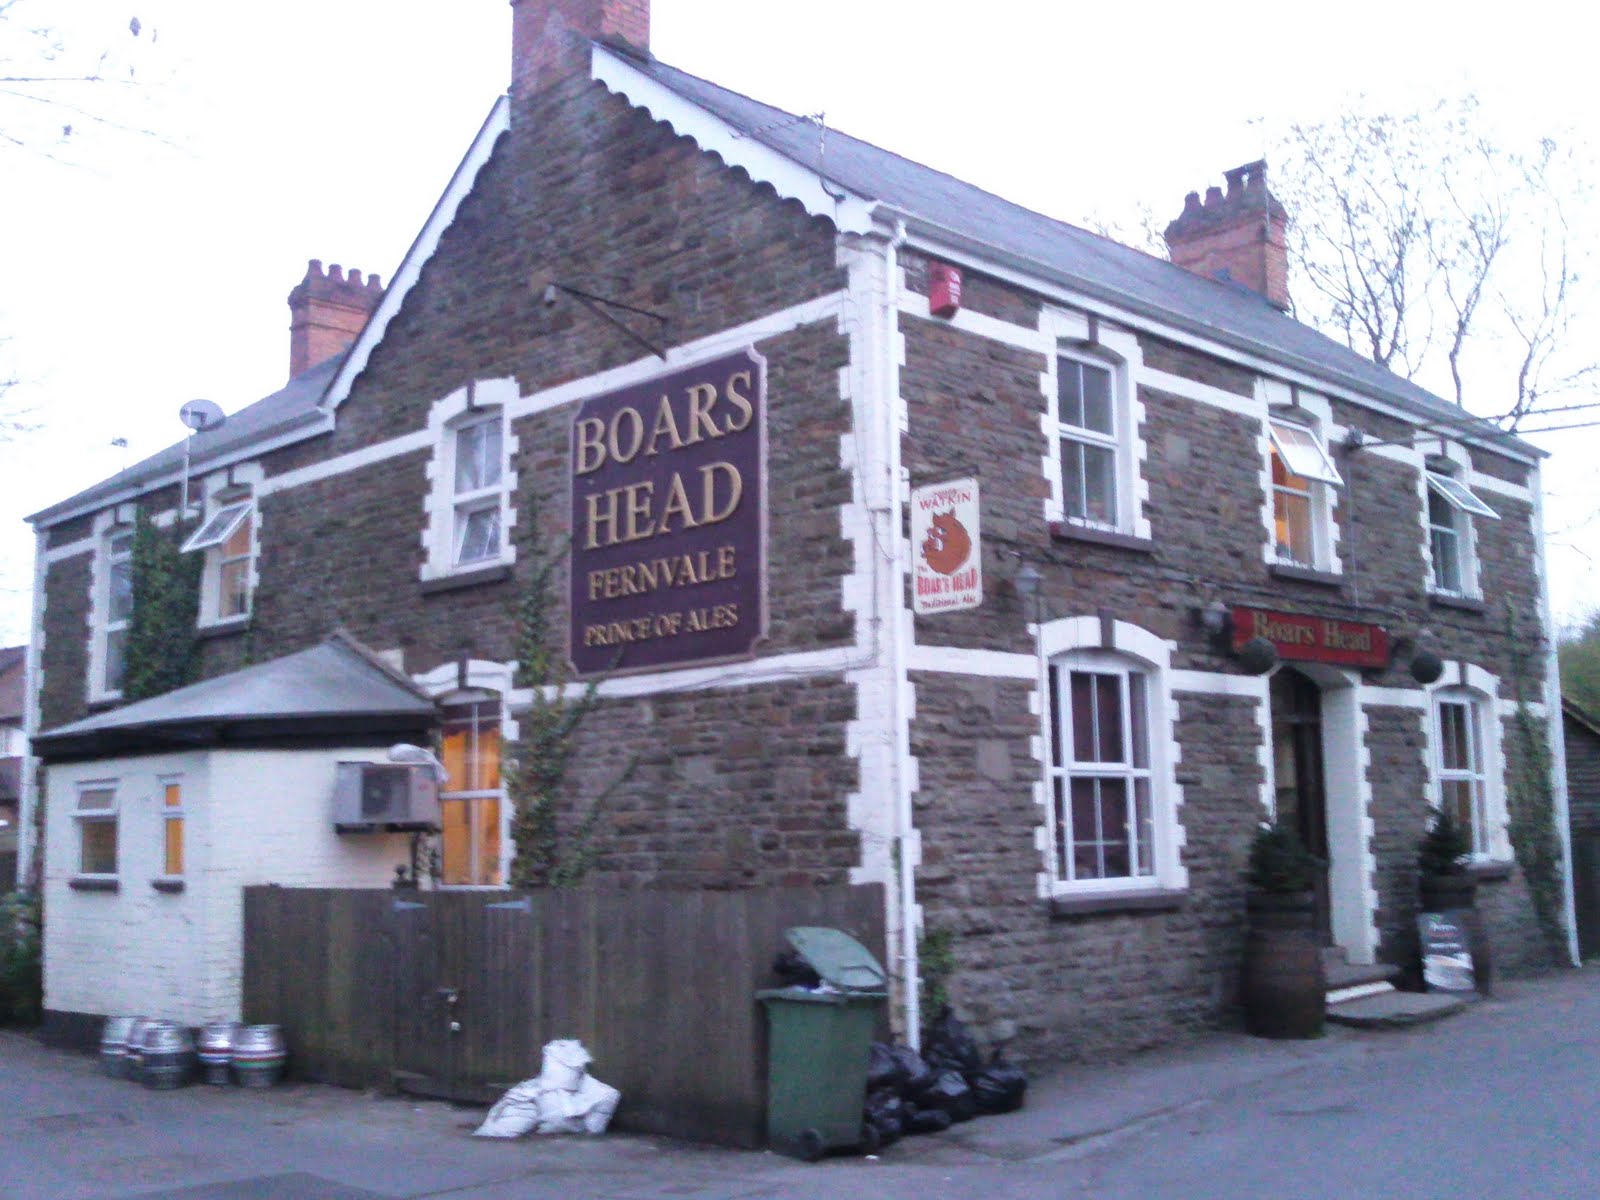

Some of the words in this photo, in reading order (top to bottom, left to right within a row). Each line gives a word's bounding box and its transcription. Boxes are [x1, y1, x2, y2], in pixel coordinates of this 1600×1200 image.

[575, 370, 753, 475] BOARS
[583, 461, 743, 550] HEAD
[919, 490, 972, 511] WATKIN
[588, 546, 736, 600] FERNVALE
[952, 567, 978, 592] HEAD
[584, 616, 651, 648] PRINCE
[654, 611, 682, 638] OF
[687, 603, 739, 633] ALES
[1323, 620, 1372, 651] Head
